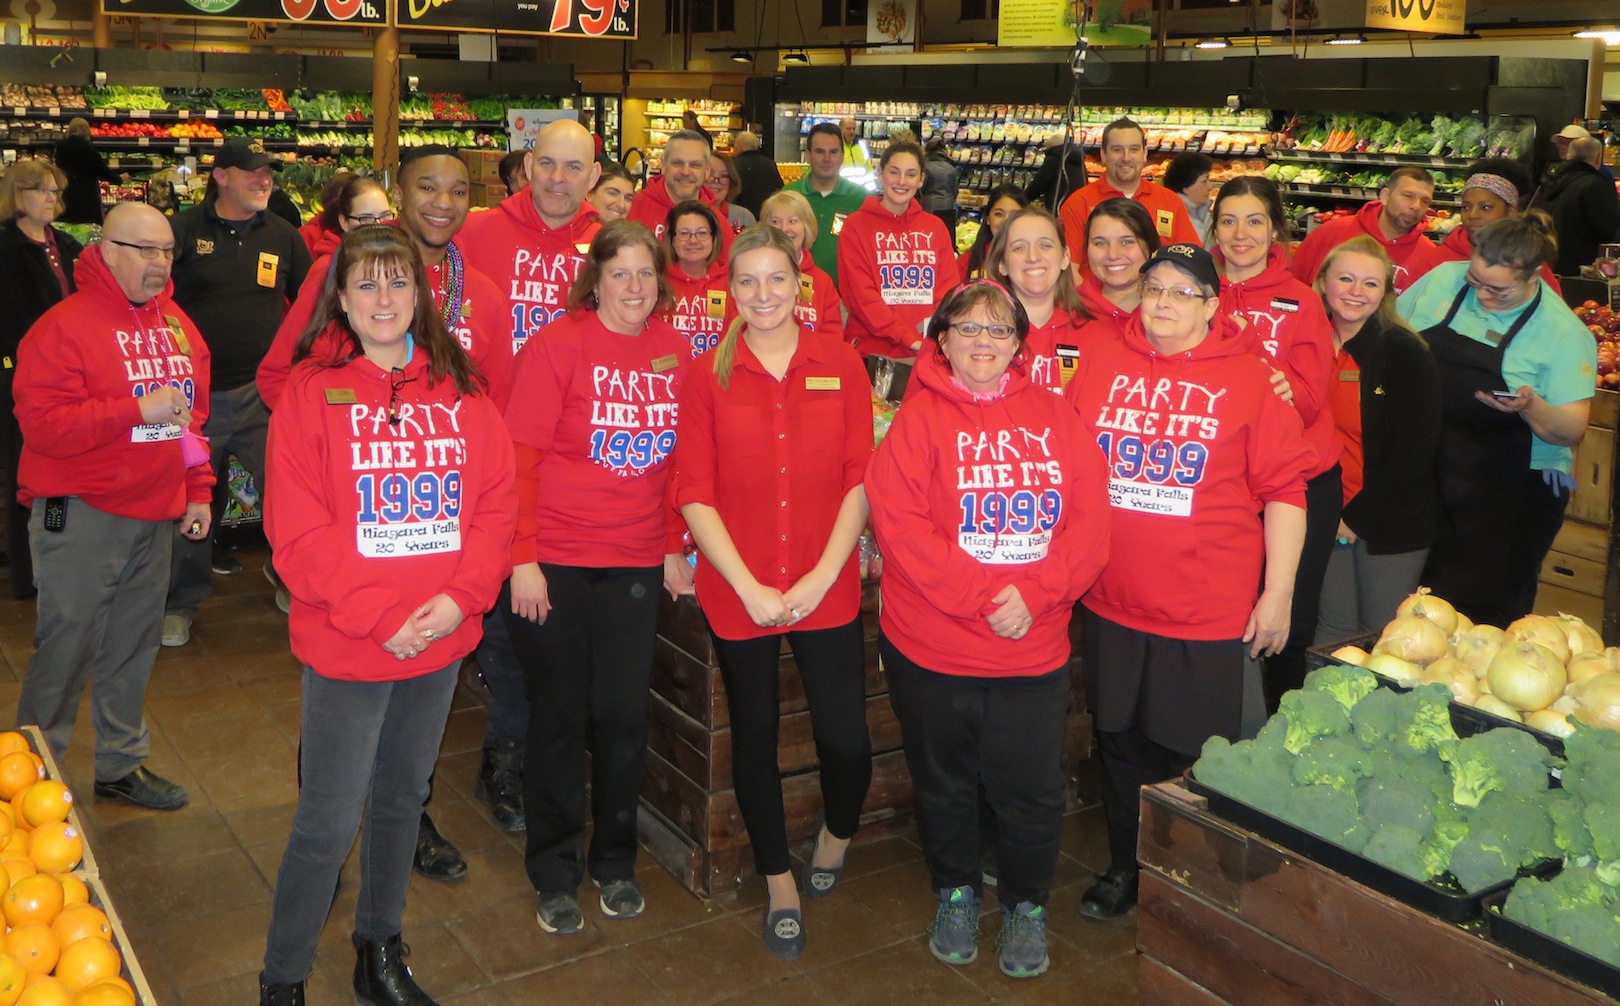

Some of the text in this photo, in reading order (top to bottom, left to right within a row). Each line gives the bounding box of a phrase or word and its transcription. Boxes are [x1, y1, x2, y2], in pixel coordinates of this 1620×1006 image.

[361, 2, 380, 18] lb.
[613, 17, 629, 32] lb.
[875, 232, 933, 250] PARTY
[515, 249, 586, 282] PART
[876, 250, 909, 265] LIKE
[880, 265, 935, 289] 1999
[510, 280, 559, 305] LIKE
[593, 366, 675, 402] PARTY
[1107, 375, 1227, 414] PARTY
[351, 400, 462, 438] PARTY
[590, 401, 679, 428] LIKE IT'S
[1095, 406, 1219, 440] LIKE IT'S
[351, 438, 466, 470] LIKE IT'S
[588, 429, 677, 469] 1999
[957, 427, 1051, 461] PARTY
[1097, 431, 1209, 486] 1999
[957, 463, 1014, 489] LIKE
[356, 470, 463, 525] 1999
[1108, 482, 1189, 501] iagara Falls
[1131, 497, 1173, 512] Years
[959, 488, 1063, 535] 1999
[362, 521, 459, 541] Niagara Falls
[963, 534, 1050, 548] Niagara Falls
[375, 539, 449, 553] 20 Years
[975, 550, 1041, 561] 20 Years
